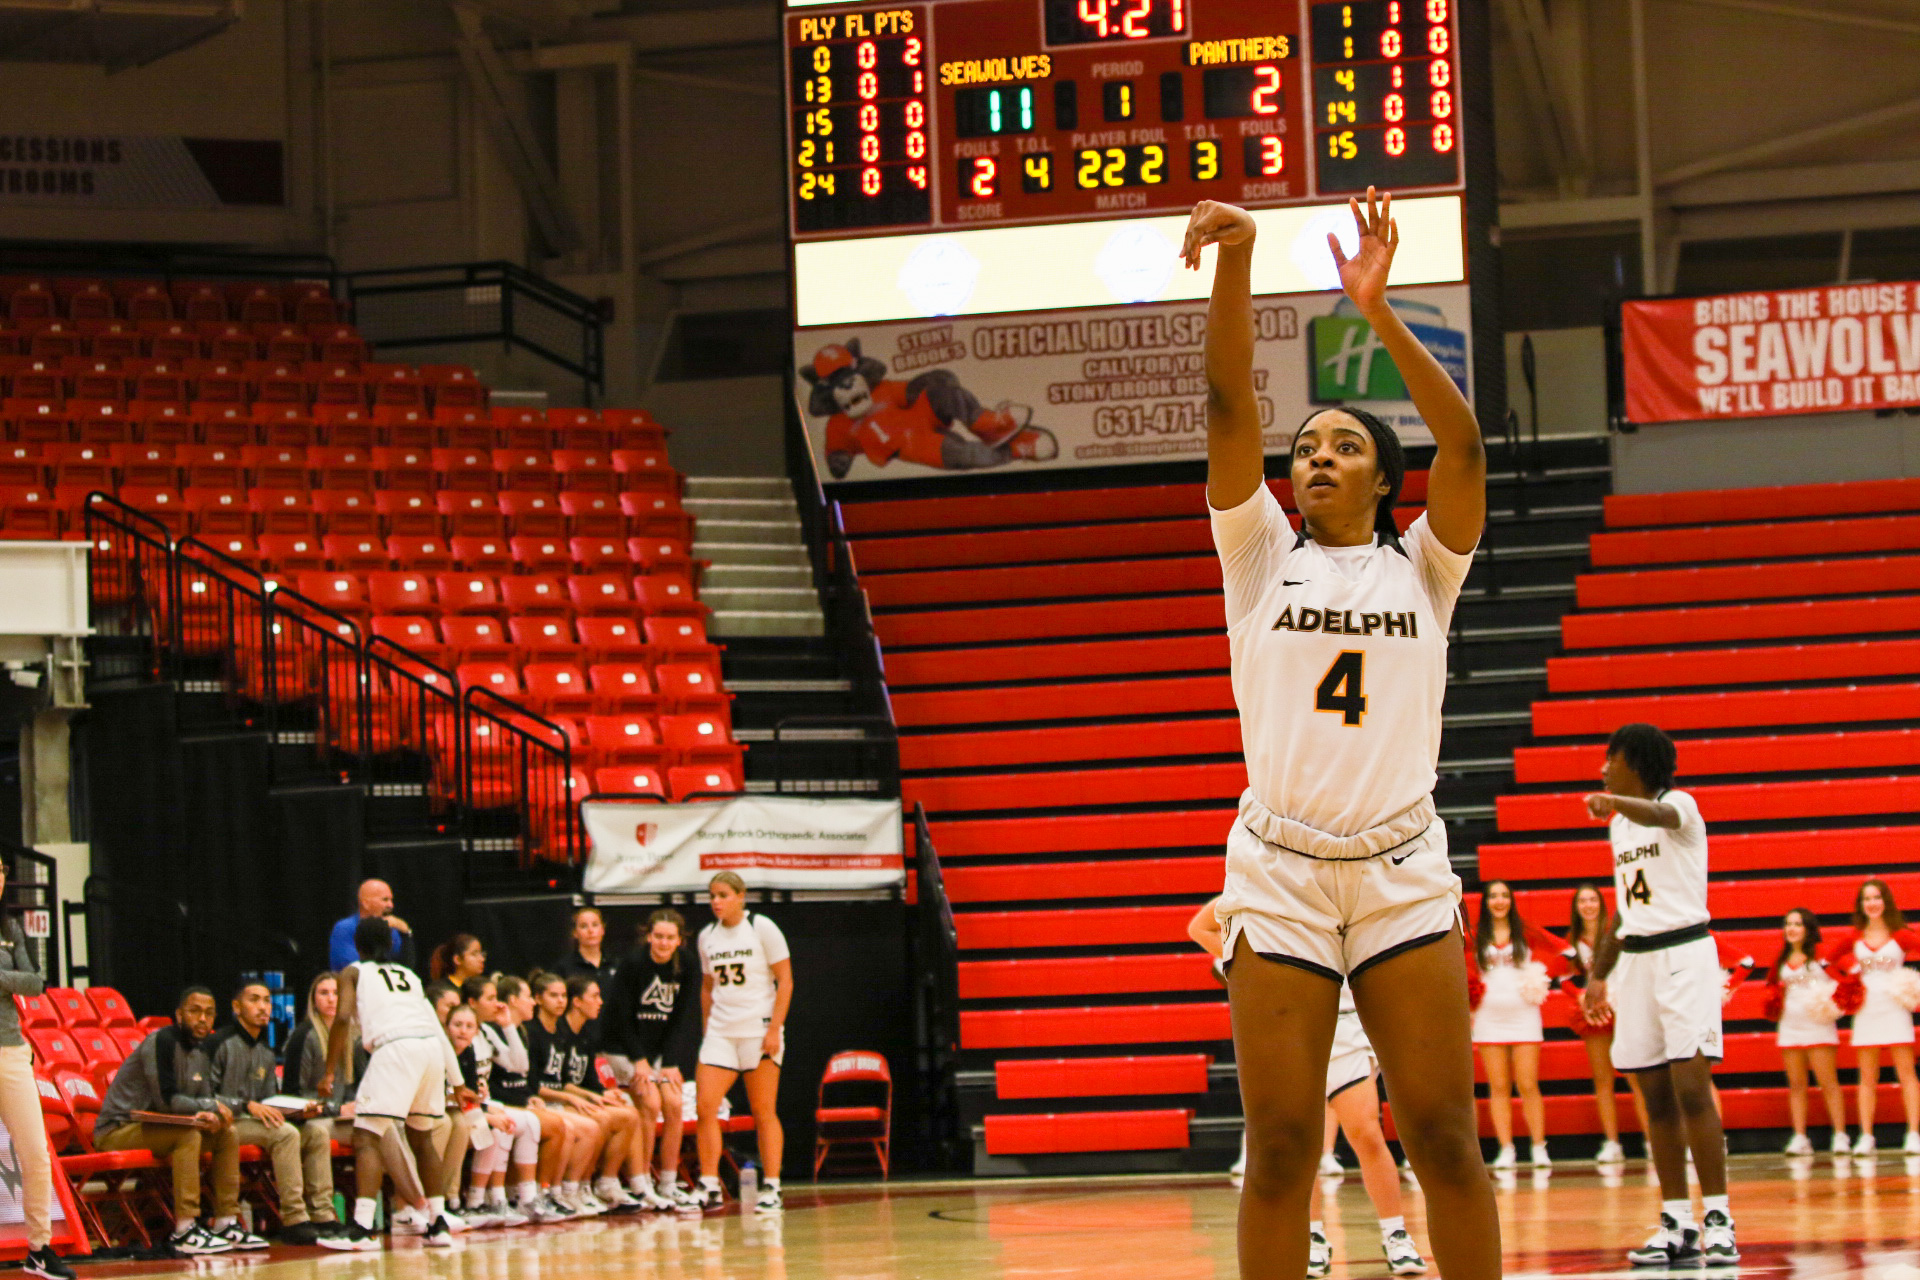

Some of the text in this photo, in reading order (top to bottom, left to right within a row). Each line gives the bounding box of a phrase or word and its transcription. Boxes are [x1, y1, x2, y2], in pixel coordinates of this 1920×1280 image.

[800, 10, 914, 41] PLY FL PTS
[1342, 0, 1448, 28] 1 1 0
[814, 37, 922, 73] 0 0 2
[1189, 35, 1289, 65] PANTHERS
[1344, 25, 1449, 59] 1 0 0
[940, 55, 1051, 86] SEAWOLVES
[1091, 60, 1143, 79] PERIOD
[1335, 58, 1450, 92] 4 1 0
[805, 70, 923, 103] 13 0 1
[1120, 85, 1131, 118] 1
[1252, 65, 1281, 115] 2
[806, 99, 924, 136] 15 0 0
[989, 87, 1032, 132] 11
[1328, 89, 1451, 125] 14 0 0
[1072, 127, 1168, 149] PLAYER FOUL
[1239, 118, 1287, 136] FOULS
[1329, 122, 1453, 159] 15 0 0
[799, 130, 925, 168] 21 0 0
[954, 139, 1000, 158] FOULS
[1197, 141, 1217, 180] 3
[1261, 136, 1284, 176] 3
[799, 165, 926, 200] 24 0 4
[972, 157, 996, 196] 2
[1026, 157, 1049, 188] 4
[1078, 144, 1164, 188] 22 2
[1096, 191, 1147, 210] MATCH
[1242, 181, 1289, 200] SCORE
[957, 203, 1003, 220] SCORE
[1694, 285, 1907, 326] BRING THE HOUSE
[897, 325, 953, 351] STONY
[972, 305, 1298, 360] OFFICIAL HOTEL SPSOR
[1084, 357, 1132, 380] CALL
[1132, 353, 1173, 376] FOR
[1049, 382, 1105, 404] STONY
[1106, 378, 1173, 402] BROOK
[1697, 385, 1764, 413] WE'LL
[1771, 378, 1843, 409] BUILD
[1852, 376, 1875, 404] IT
[1271, 603, 1418, 639] ADELPHI
[1313, 649, 1369, 728] 4
[377, 967, 412, 993] 13
[714, 962, 747, 988] 33
